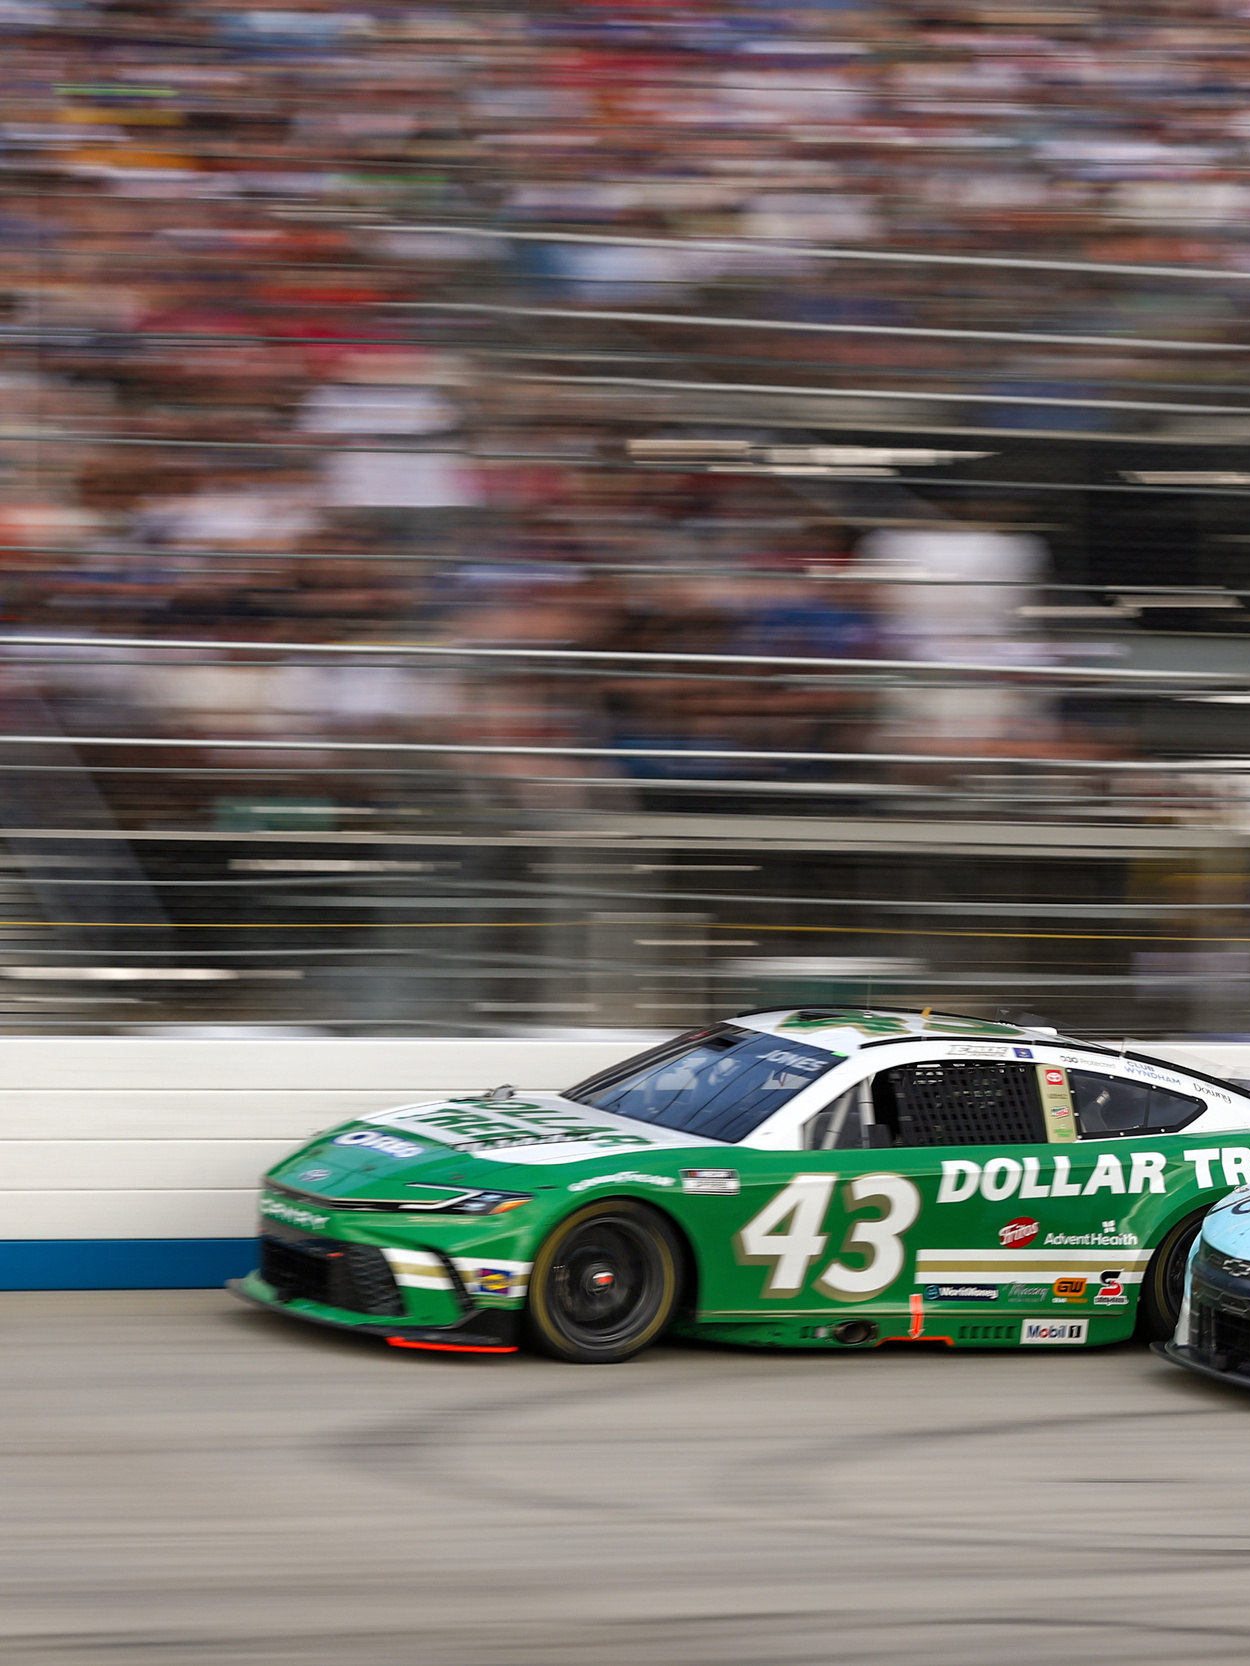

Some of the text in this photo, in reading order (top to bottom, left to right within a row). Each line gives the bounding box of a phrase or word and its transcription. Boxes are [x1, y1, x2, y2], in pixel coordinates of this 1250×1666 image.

[756, 1049, 828, 1072] JONES
[1126, 1060, 1155, 1072] CLUB
[1124, 1066, 1182, 1086] WYNDHAM
[1192, 1082, 1232, 1104] Downy
[937, 1152, 1168, 1204] DOLLAR
[737, 1172, 921, 1300] 43
[1044, 1232, 1139, 1246] AdventHealth
[1026, 1325, 1081, 1339] Mobil 1
